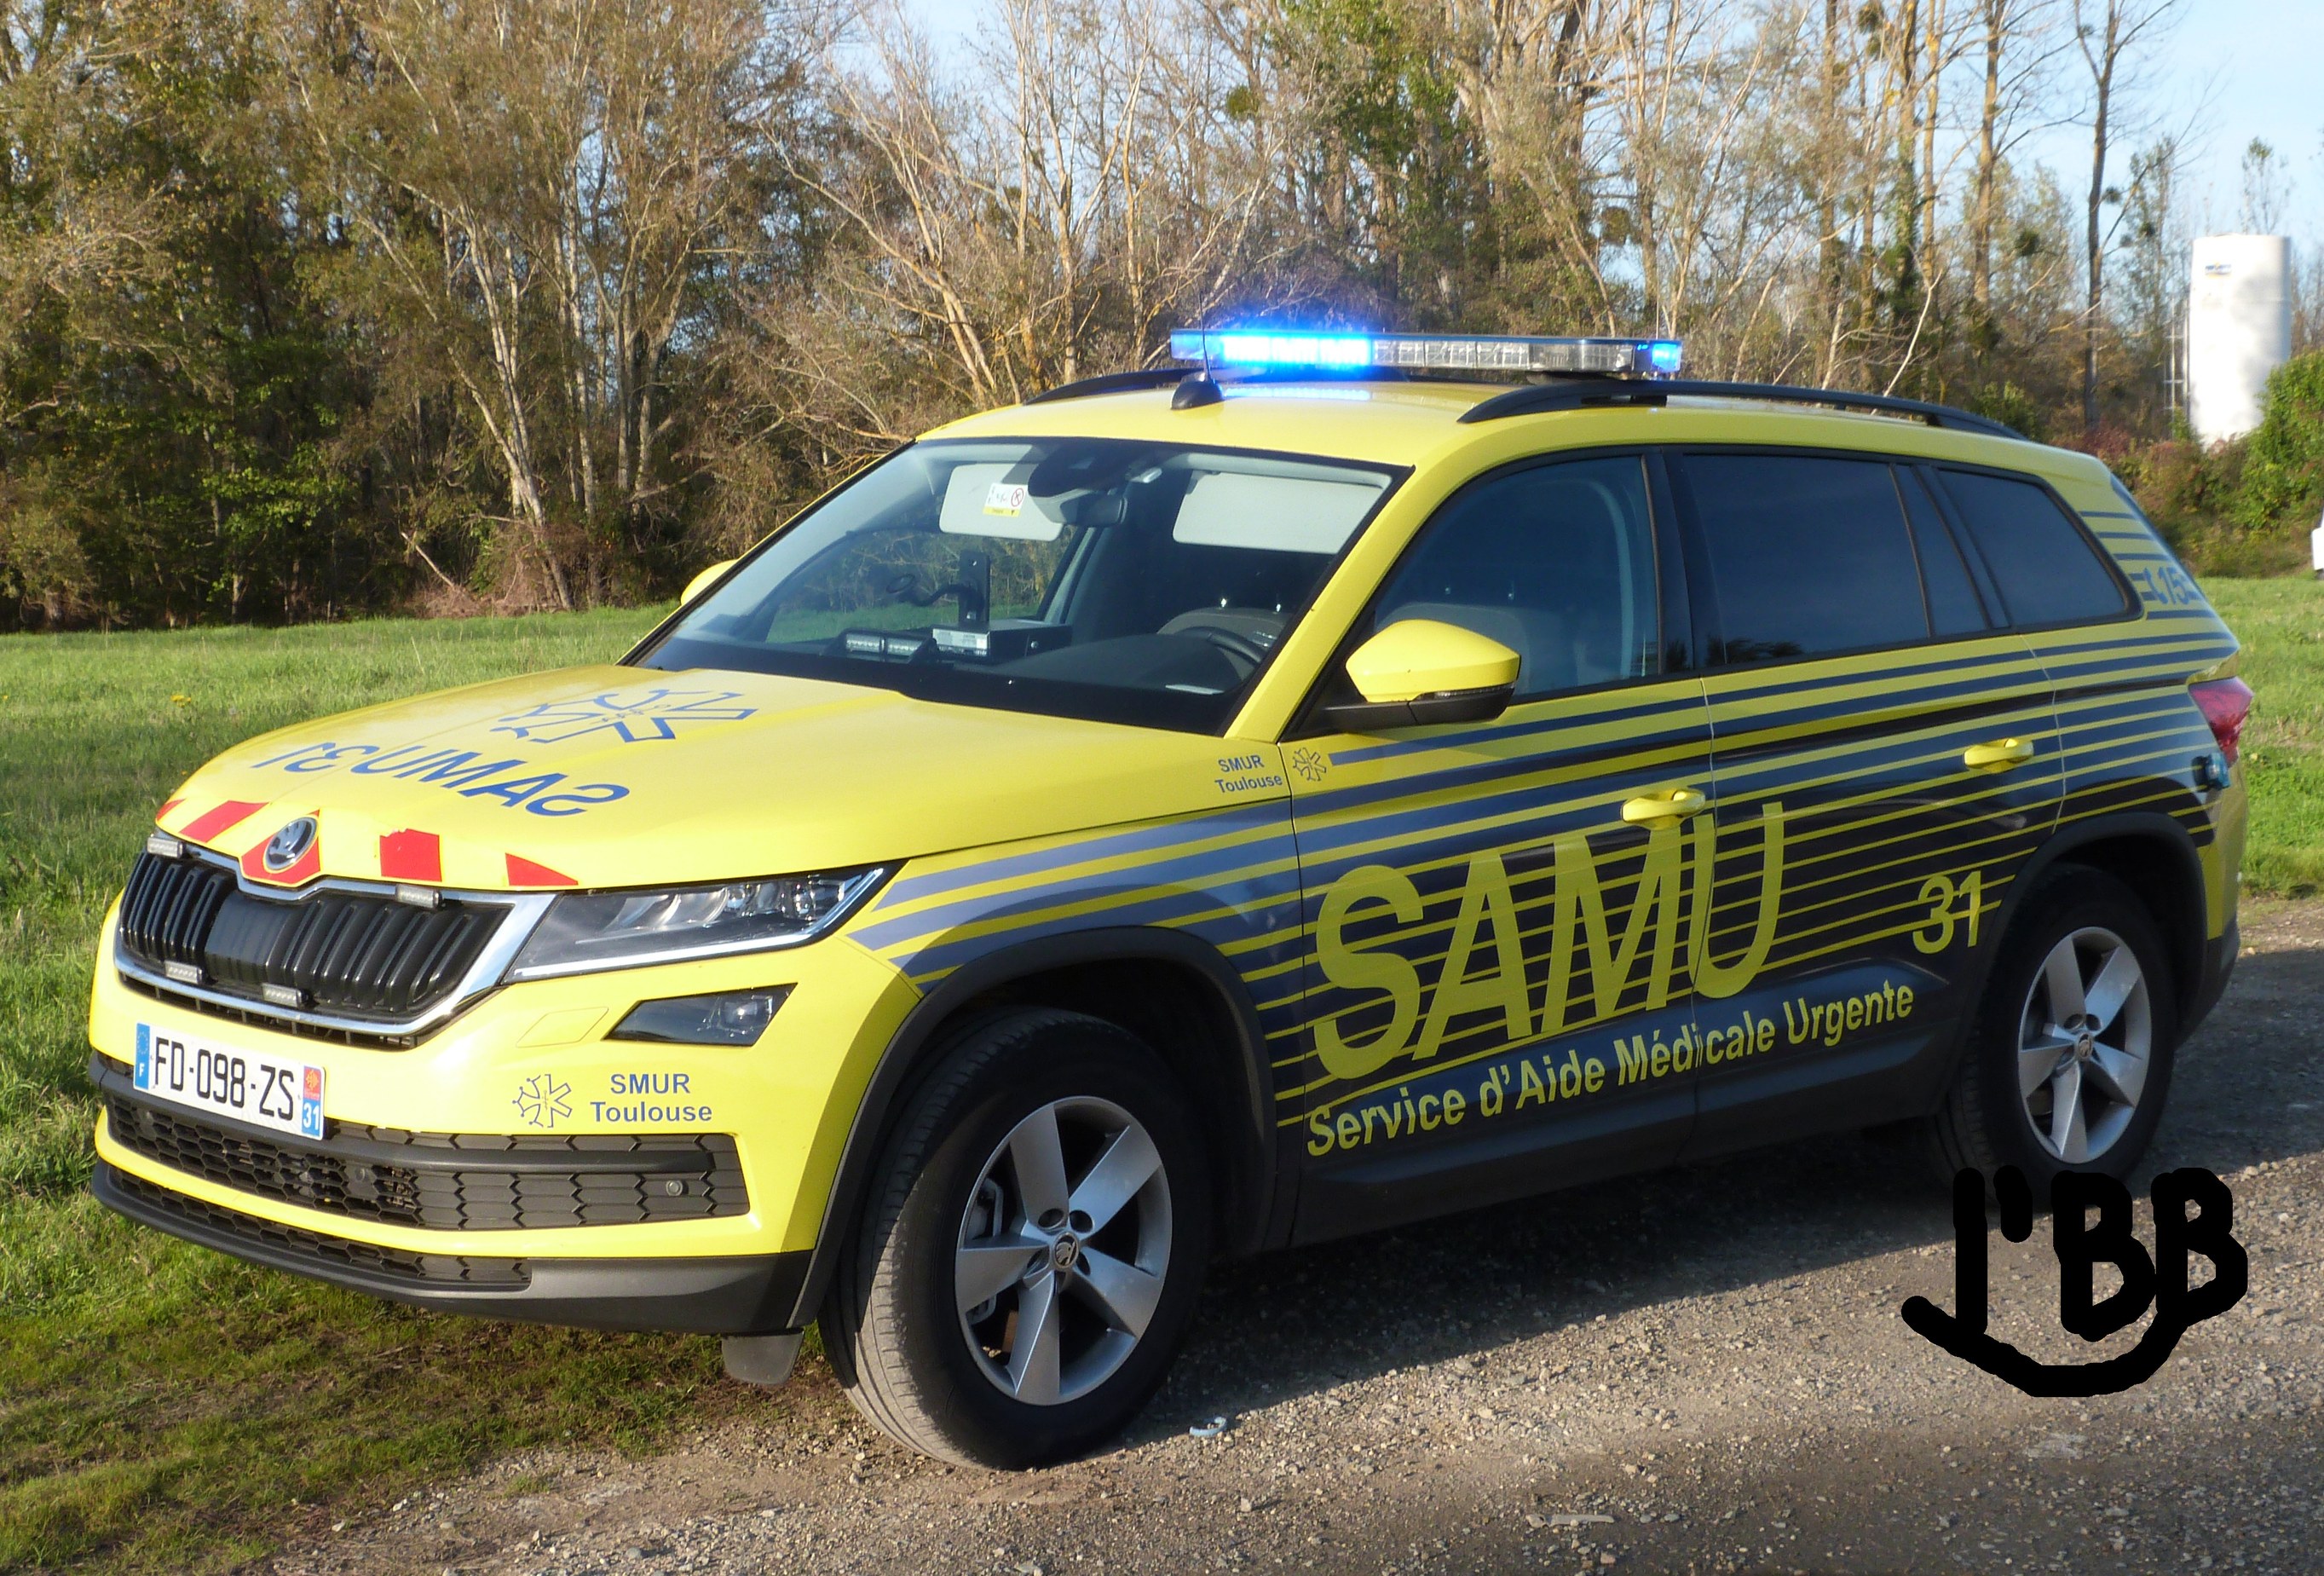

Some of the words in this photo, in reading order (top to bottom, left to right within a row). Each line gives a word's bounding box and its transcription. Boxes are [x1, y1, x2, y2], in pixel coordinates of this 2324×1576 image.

[1218, 754, 1265, 772] SMUR
[1214, 775, 1283, 794] Toulouse
[1312, 801, 1785, 1080] SAMU
[1912, 870, 1982, 955] 31
[138, 1063, 145, 1077] F
[155, 1036, 295, 1121] FD-098-ZS
[1307, 1087, 1466, 1157] Service
[1479, 1049, 1606, 1117] d'Aide
[1613, 1008, 1776, 1083] Médicale
[1783, 979, 1914, 1047] Urgente
[609, 1073, 691, 1094] SMUR
[303, 1102, 320, 1131] 31
[590, 1101, 712, 1123] Toulouse
